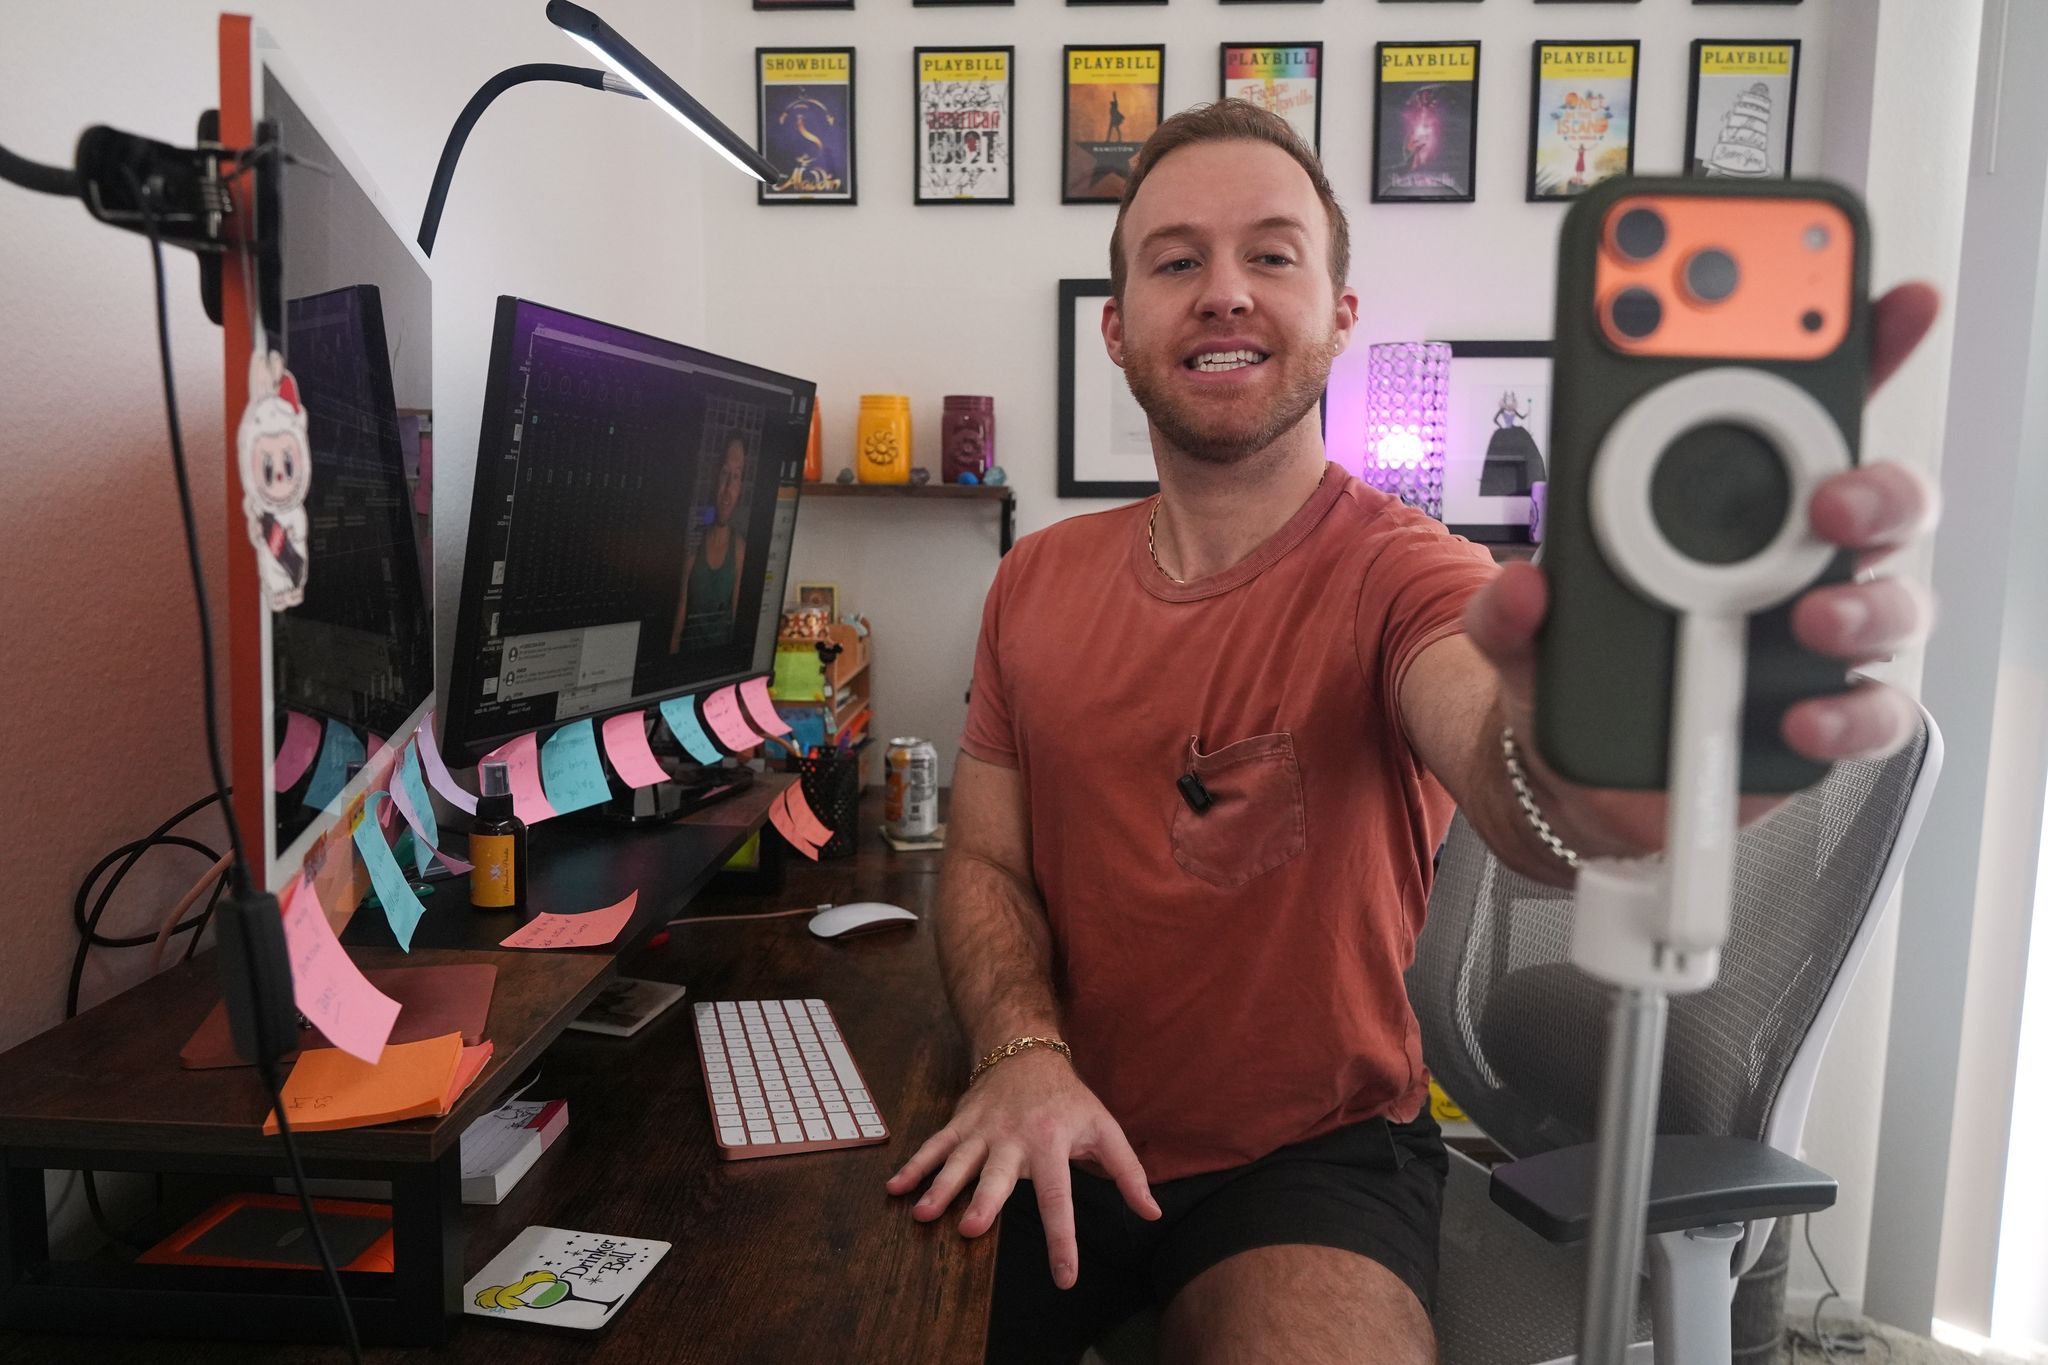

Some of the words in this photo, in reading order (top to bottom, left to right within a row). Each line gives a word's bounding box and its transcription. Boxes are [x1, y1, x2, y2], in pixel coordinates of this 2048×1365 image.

[766, 58, 847, 70] SHOWBILL
[1073, 56, 1155, 70] PLAYBILL
[1227, 52, 1315, 65] PLAYBILL
[1383, 53, 1470, 67] PLAYBILL
[1543, 51, 1627, 64] PLAYBILL
[1704, 51, 1788, 64] PLAYBILL
[924, 58, 1004, 72] PLAYBILL
[928, 130, 999, 164] IDIOT
[560, 1239, 617, 1279] Drinker
[599, 1250, 637, 1275] Bell
